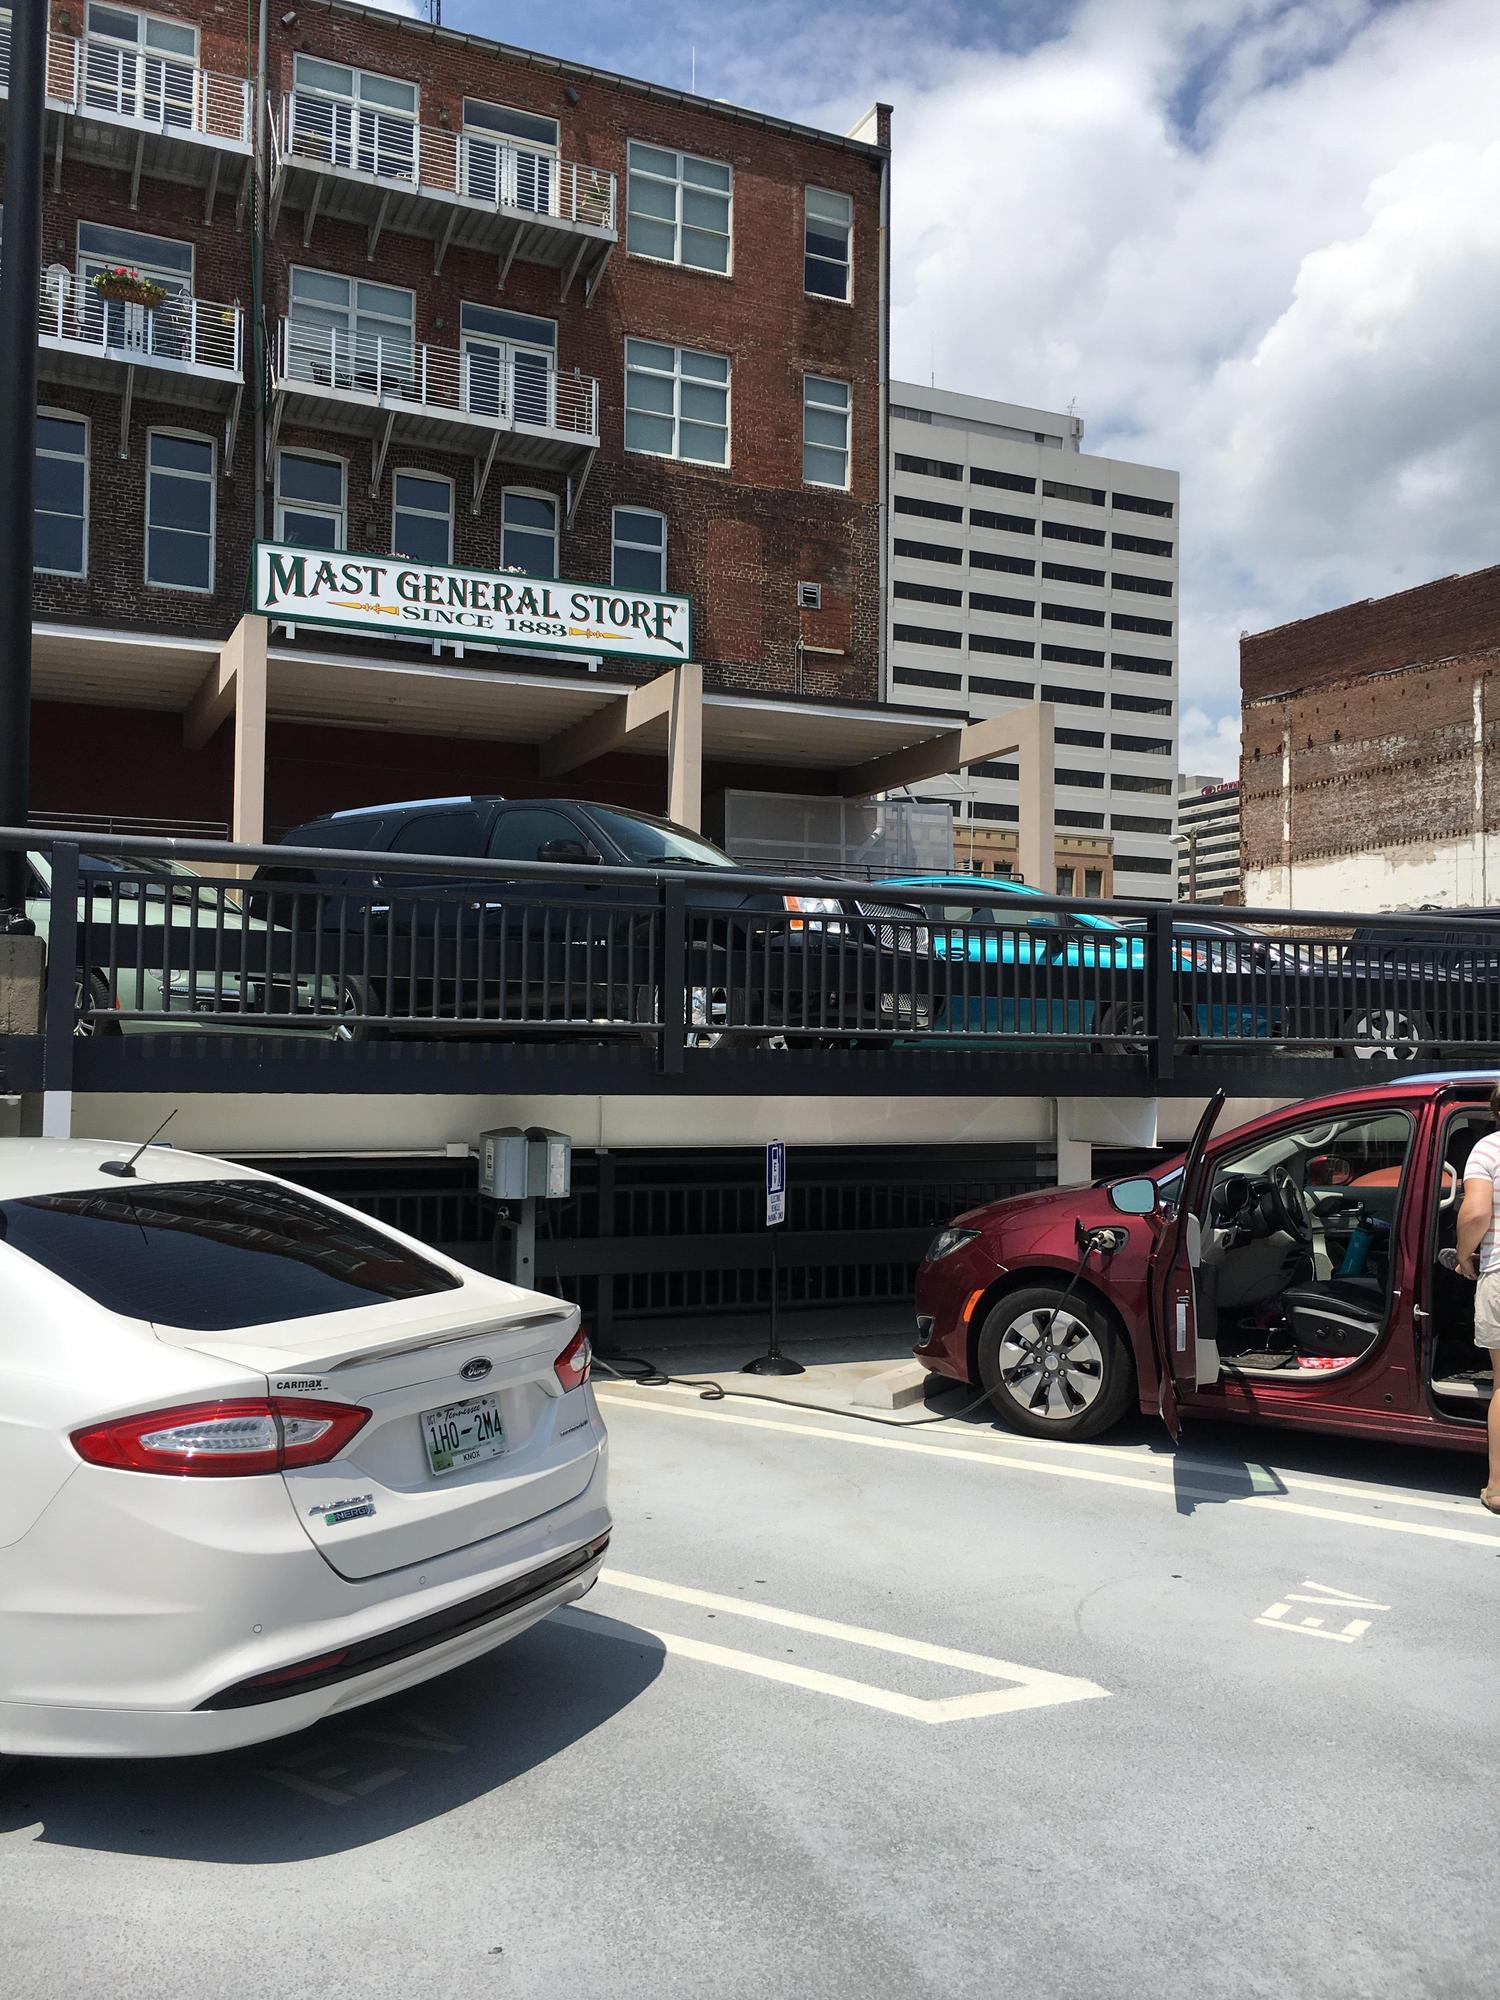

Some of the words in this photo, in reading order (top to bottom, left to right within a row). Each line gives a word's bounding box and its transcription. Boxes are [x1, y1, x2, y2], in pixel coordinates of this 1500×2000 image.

[264, 552, 388, 607] MAST
[396, 571, 561, 620] GENERAL
[569, 593, 685, 653] STORE
[402, 605, 494, 630] SINCE
[506, 618, 568, 637] 1883
[444, 1404, 481, 1422] Tennessee
[463, 1449, 481, 1461] KNOX
[1252, 1580, 1392, 1644] EV
